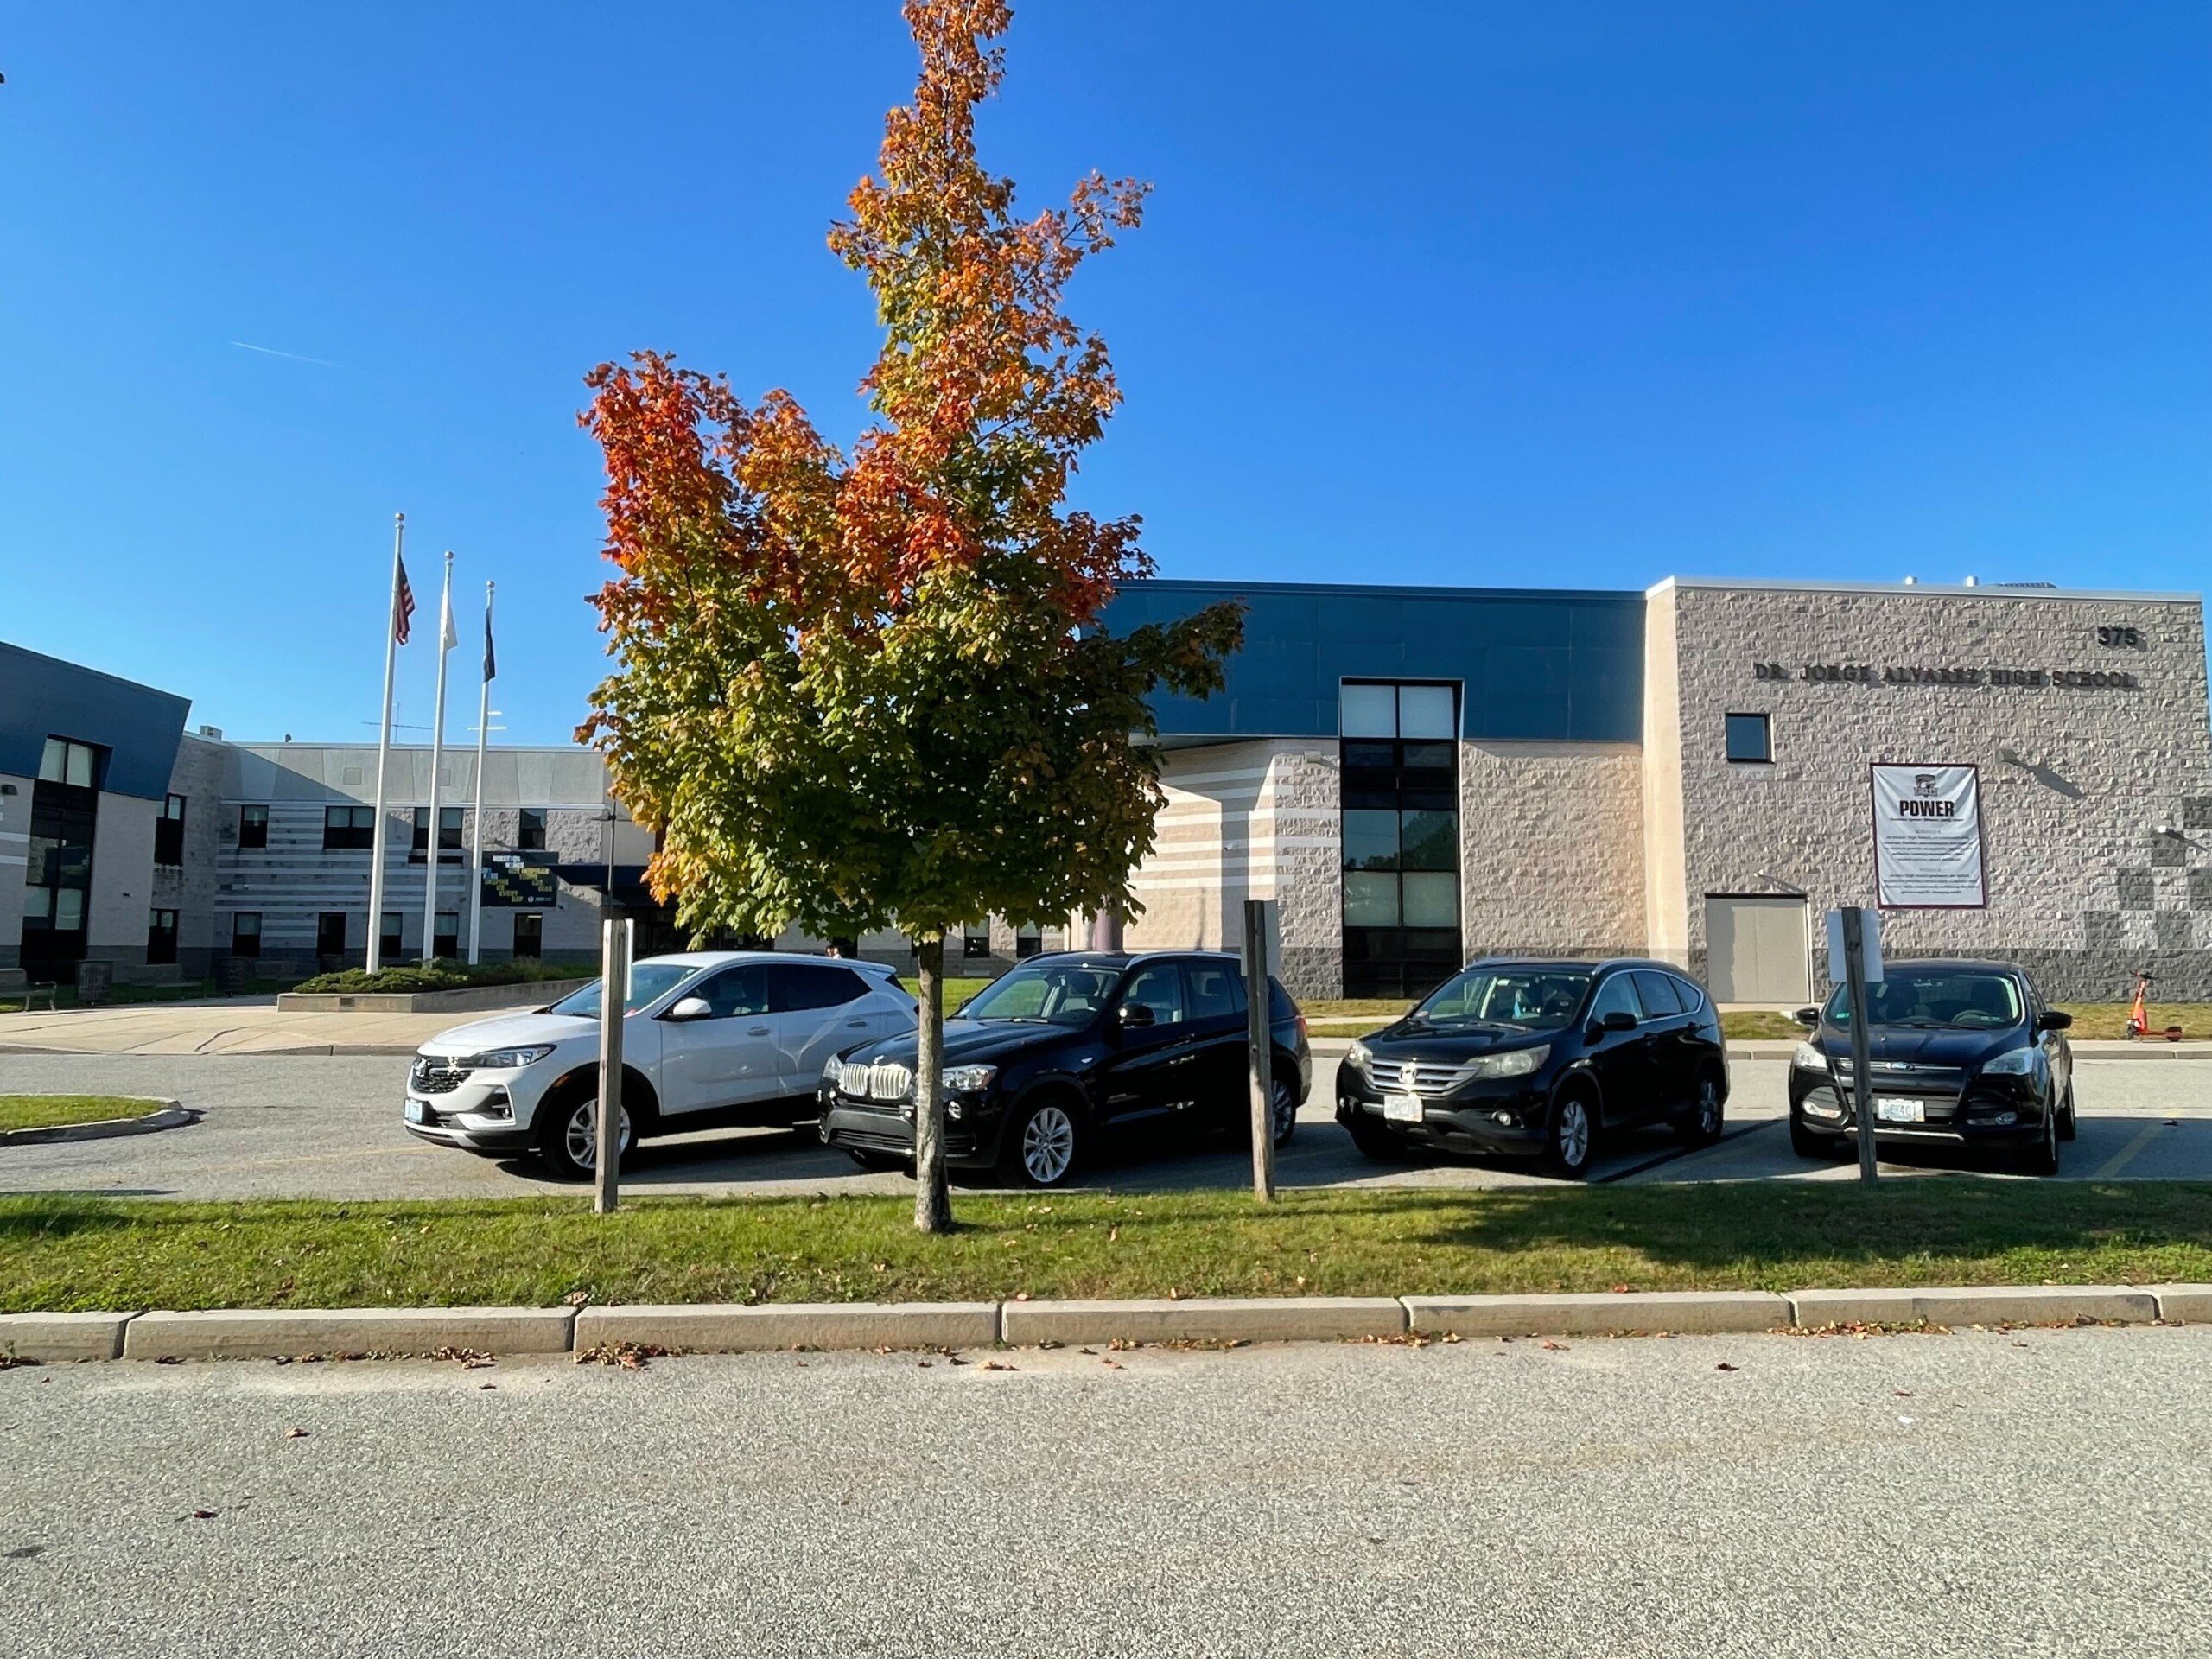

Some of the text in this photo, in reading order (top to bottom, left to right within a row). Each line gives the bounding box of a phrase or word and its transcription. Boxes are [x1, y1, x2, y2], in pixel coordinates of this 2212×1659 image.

[2097, 626, 2139, 646] 375
[1800, 664, 1872, 682] JORGE
[1882, 666, 1979, 684] ALVAREZ
[1989, 669, 2041, 686] HIGH
[2052, 671, 2134, 688] SCHOOL
[1899, 800, 1955, 817] POWER
